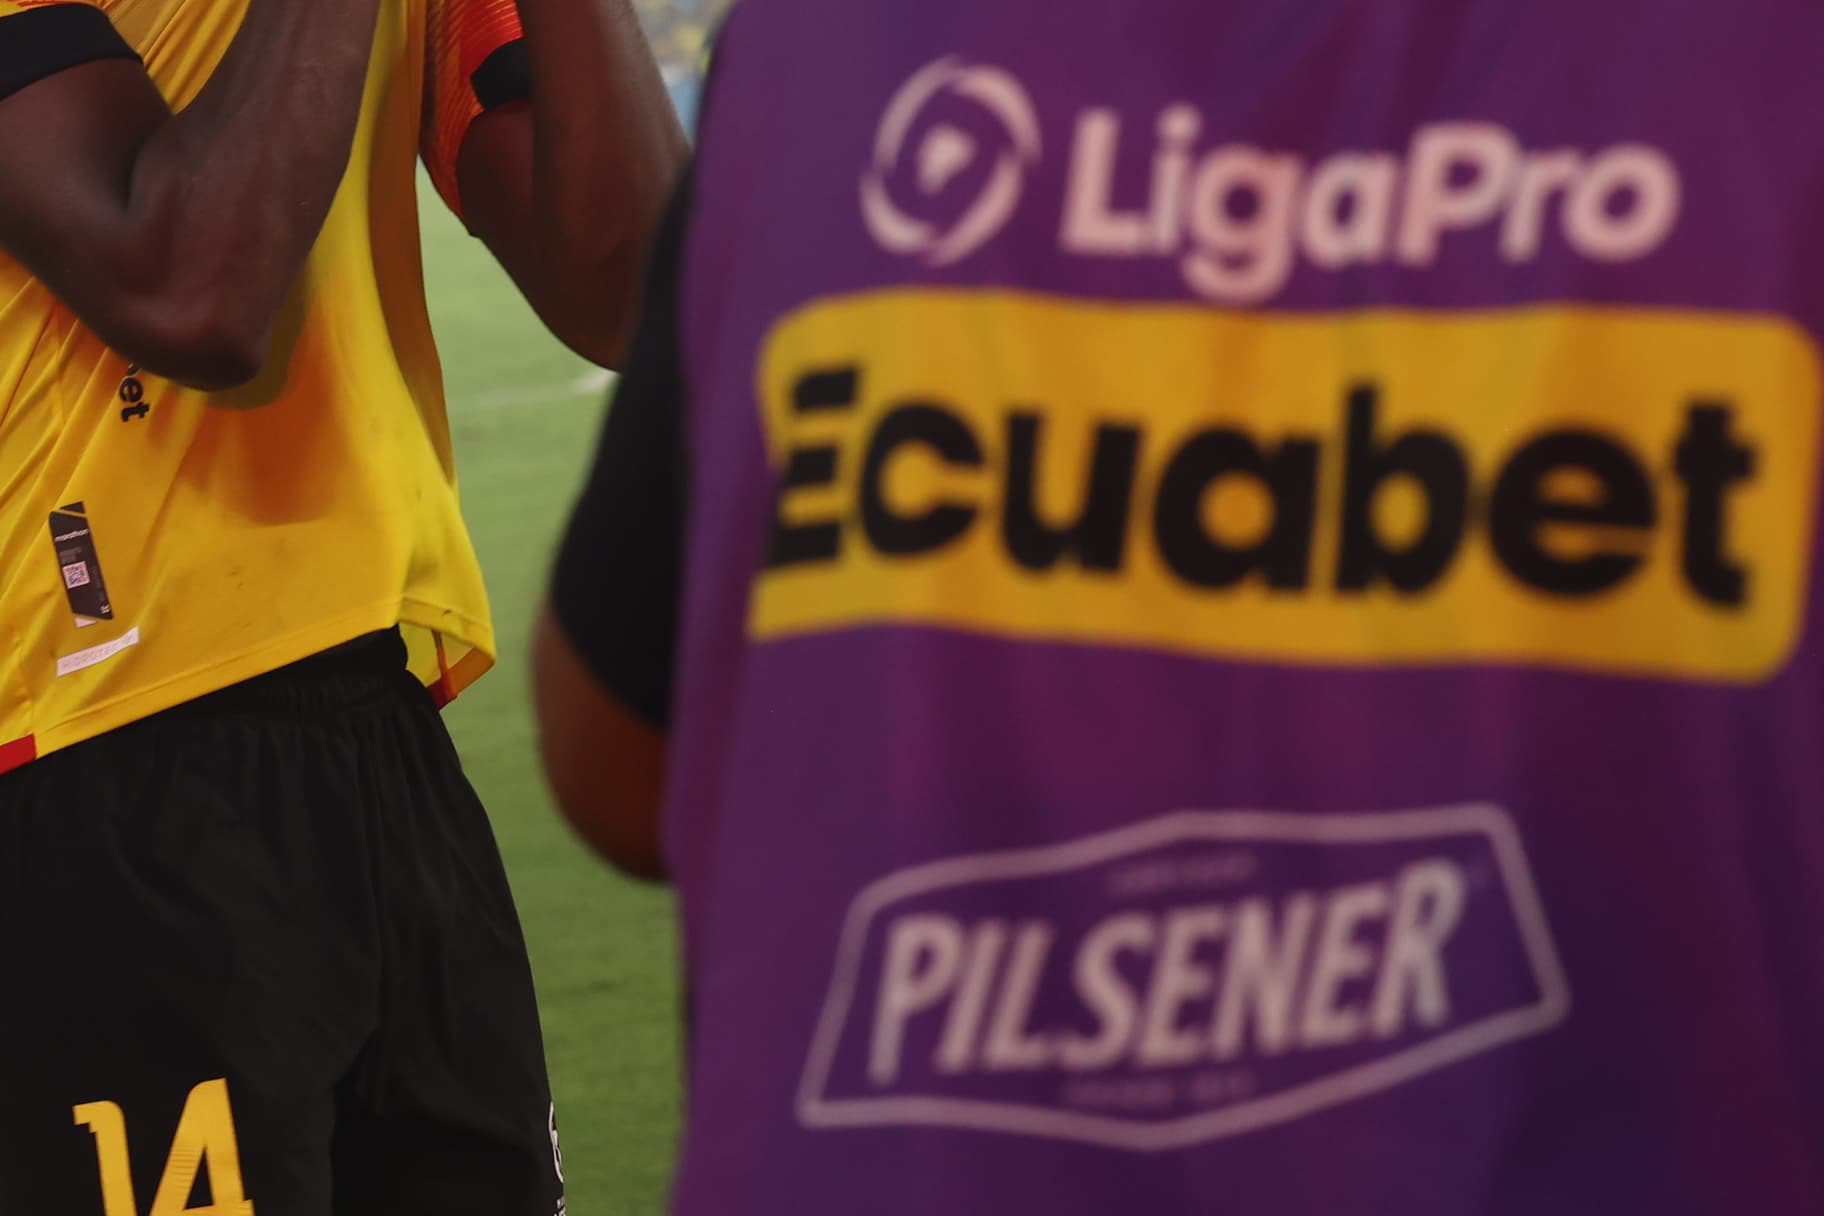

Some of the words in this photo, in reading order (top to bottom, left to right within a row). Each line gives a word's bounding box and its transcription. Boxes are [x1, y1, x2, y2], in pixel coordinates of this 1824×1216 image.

[1058, 104, 1681, 304] LigaPro
[774, 359, 1760, 616] Ecuabet
[866, 858, 1470, 1088] PILSENER
[72, 1076, 257, 1216] 14
